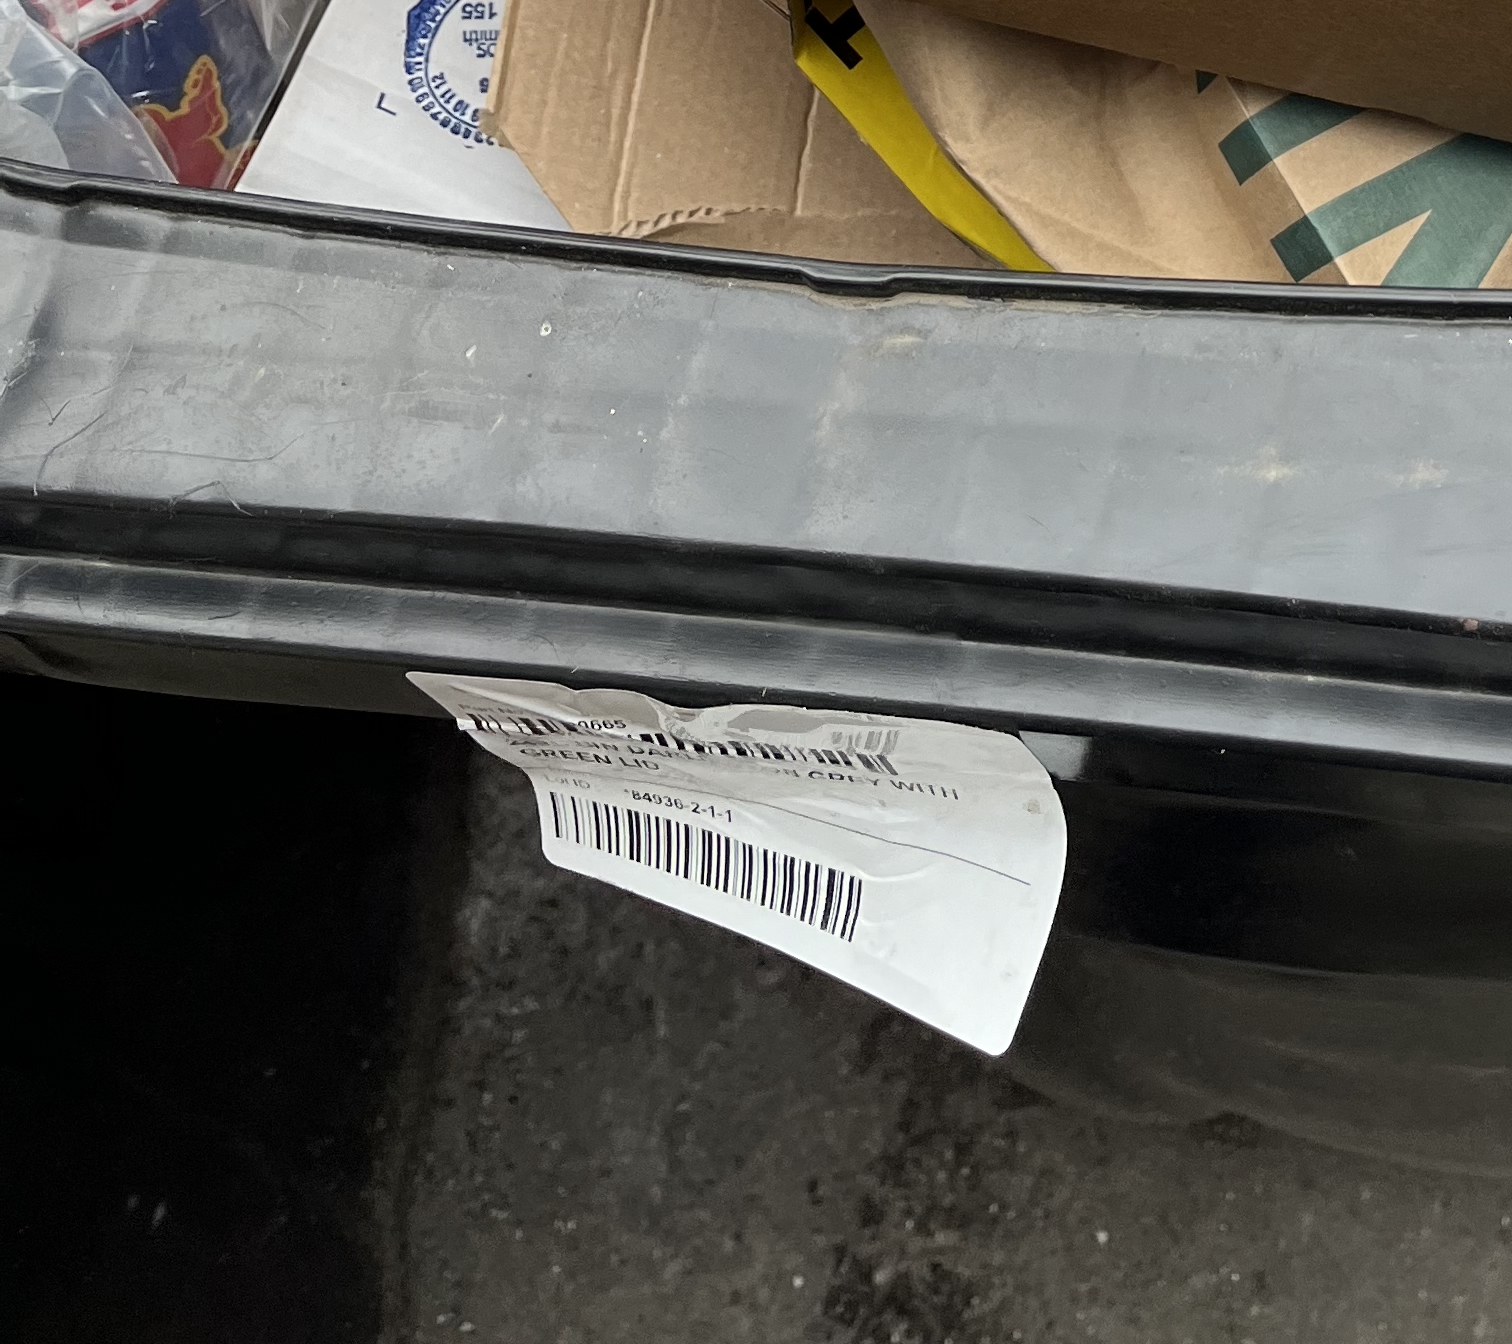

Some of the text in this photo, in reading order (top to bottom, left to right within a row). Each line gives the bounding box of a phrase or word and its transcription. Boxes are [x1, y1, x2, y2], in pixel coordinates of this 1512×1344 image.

[461, 3, 497, 20] 155
[453, 99, 470, 116] 10
[520, 748, 660, 770] GREEN LID
